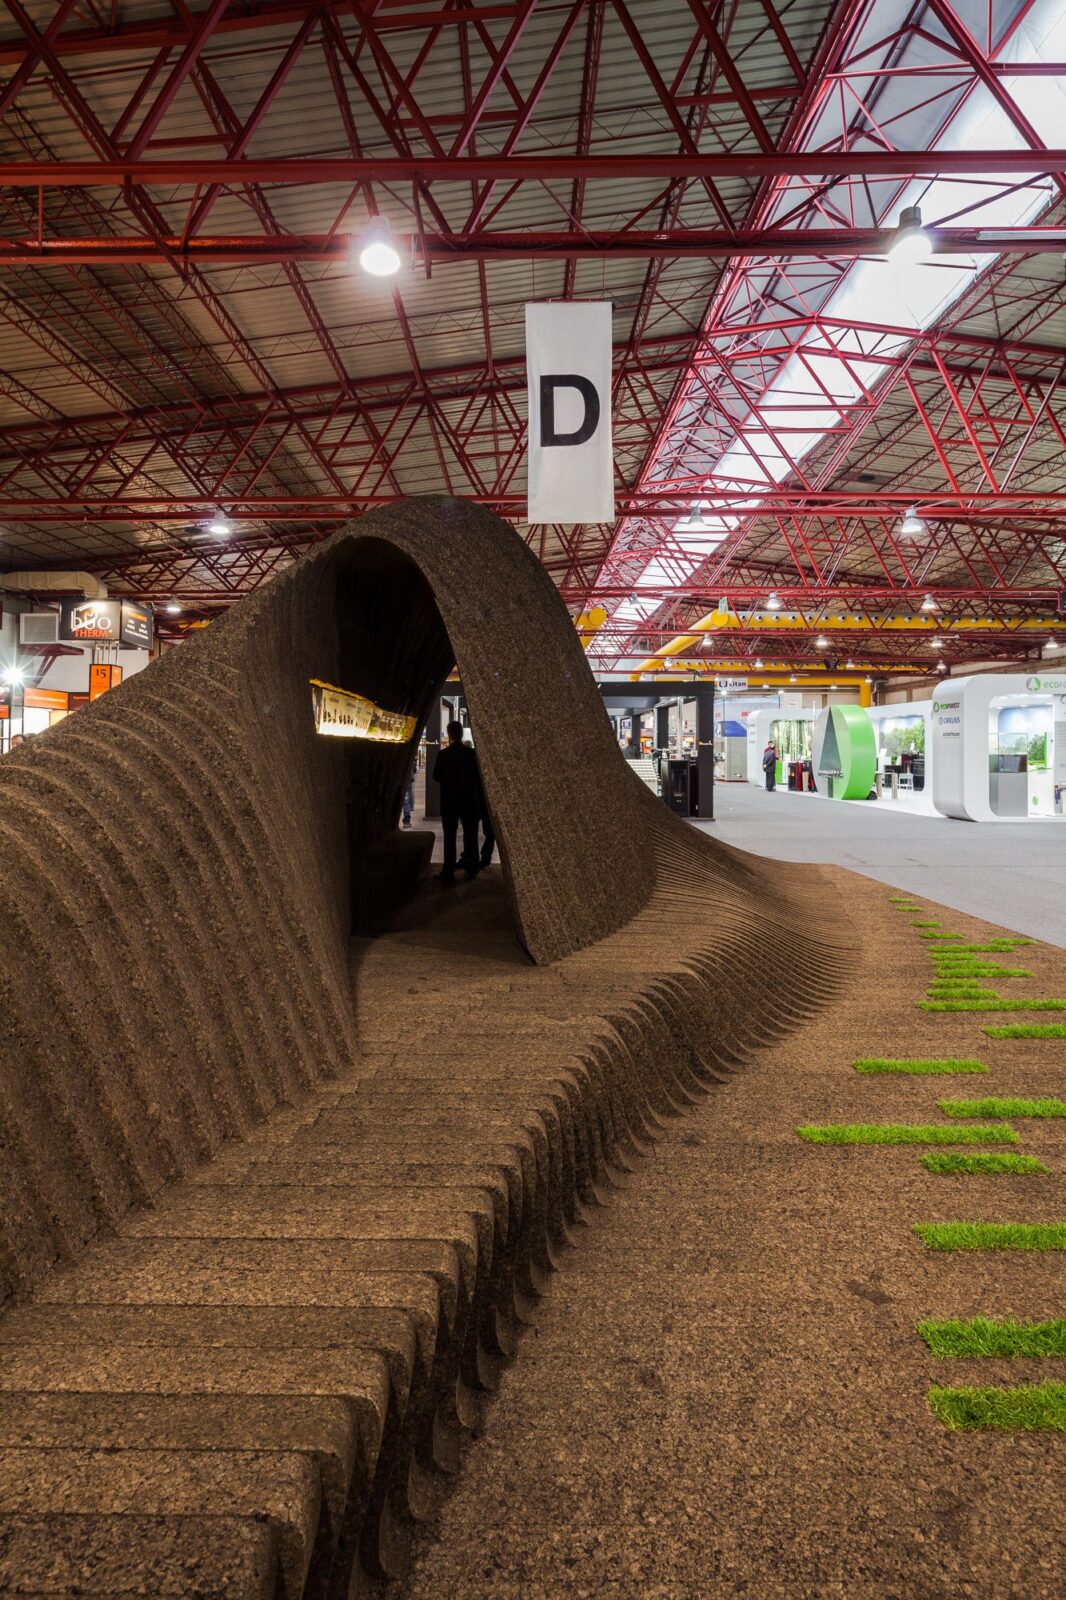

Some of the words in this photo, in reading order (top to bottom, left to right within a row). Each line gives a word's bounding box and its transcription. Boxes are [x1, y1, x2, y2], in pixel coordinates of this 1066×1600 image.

[540, 374, 600, 447] D
[75, 629, 109, 638] THERM
[96, 668, 107, 679] 15
